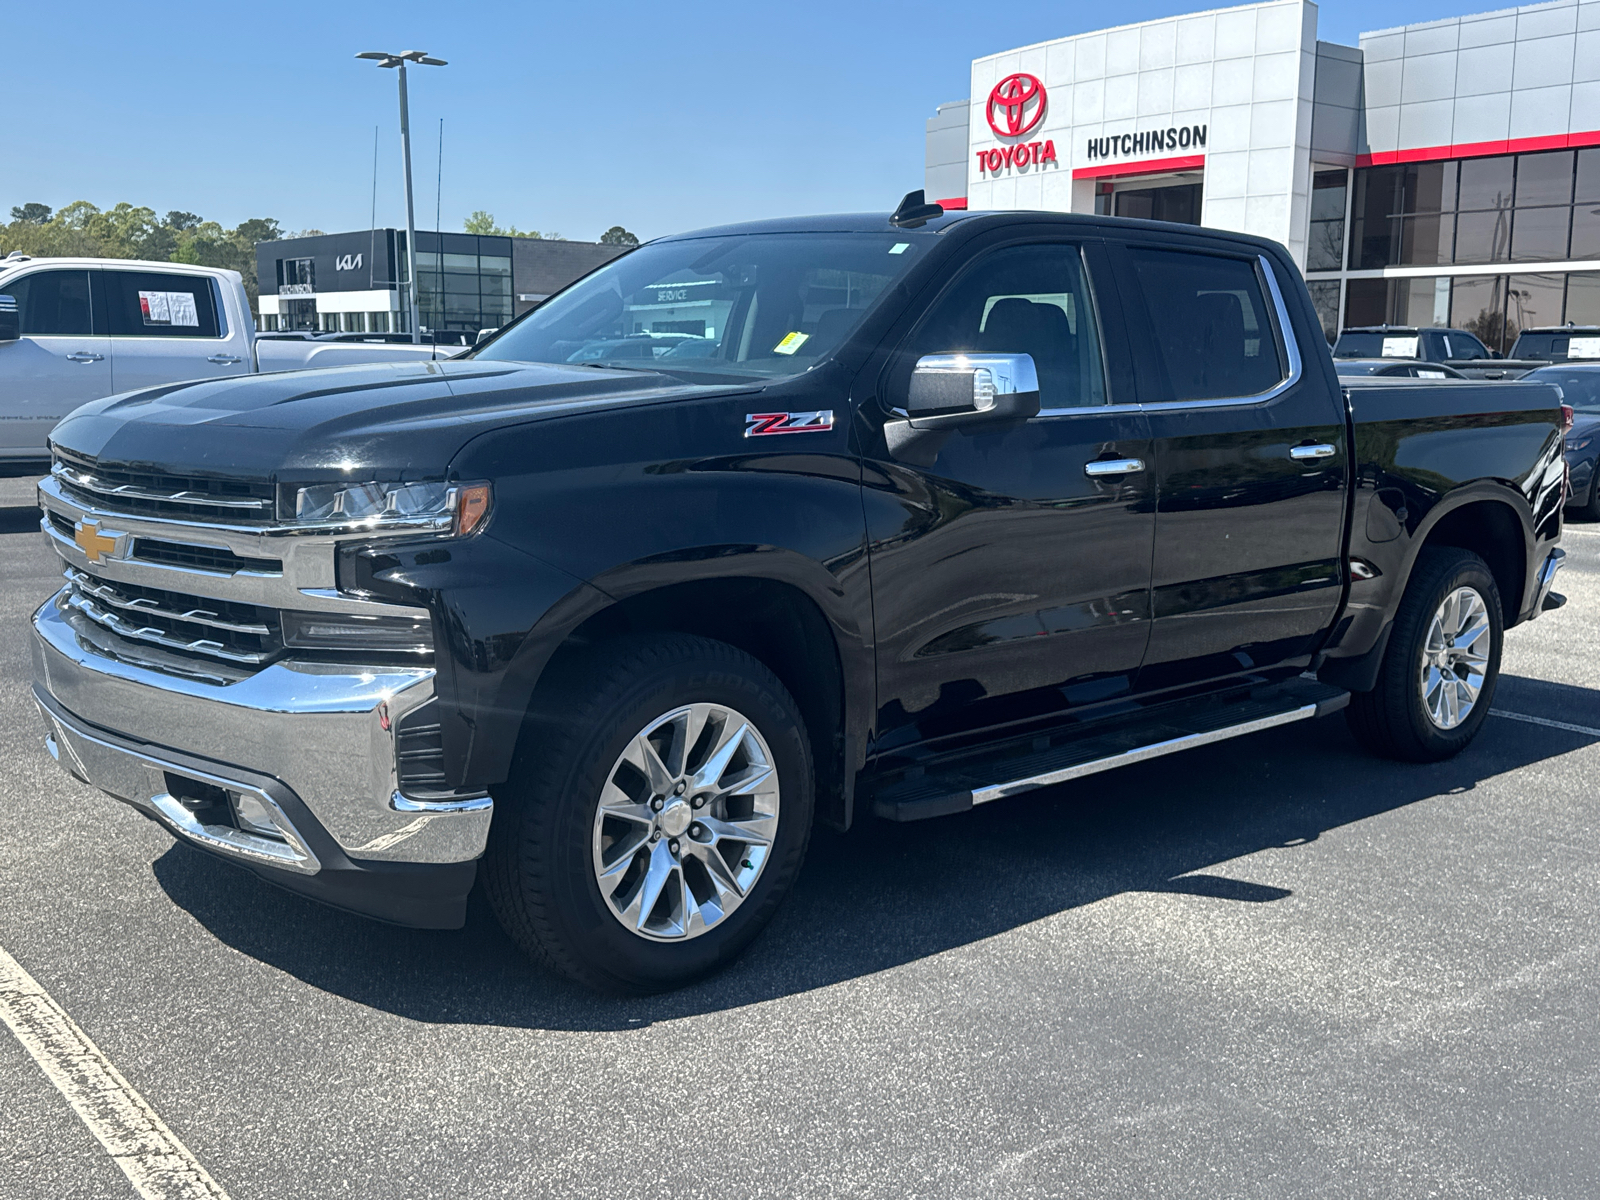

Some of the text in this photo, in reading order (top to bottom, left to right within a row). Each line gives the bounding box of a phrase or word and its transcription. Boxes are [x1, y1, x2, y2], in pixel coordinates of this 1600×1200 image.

[1087, 124, 1208, 158] HUTCHINSON
[976, 139, 1057, 172] TOYOTA
[336, 253, 362, 271] KIA
[657, 289, 687, 302] SERVICE
[744, 410, 833, 438] Z71
